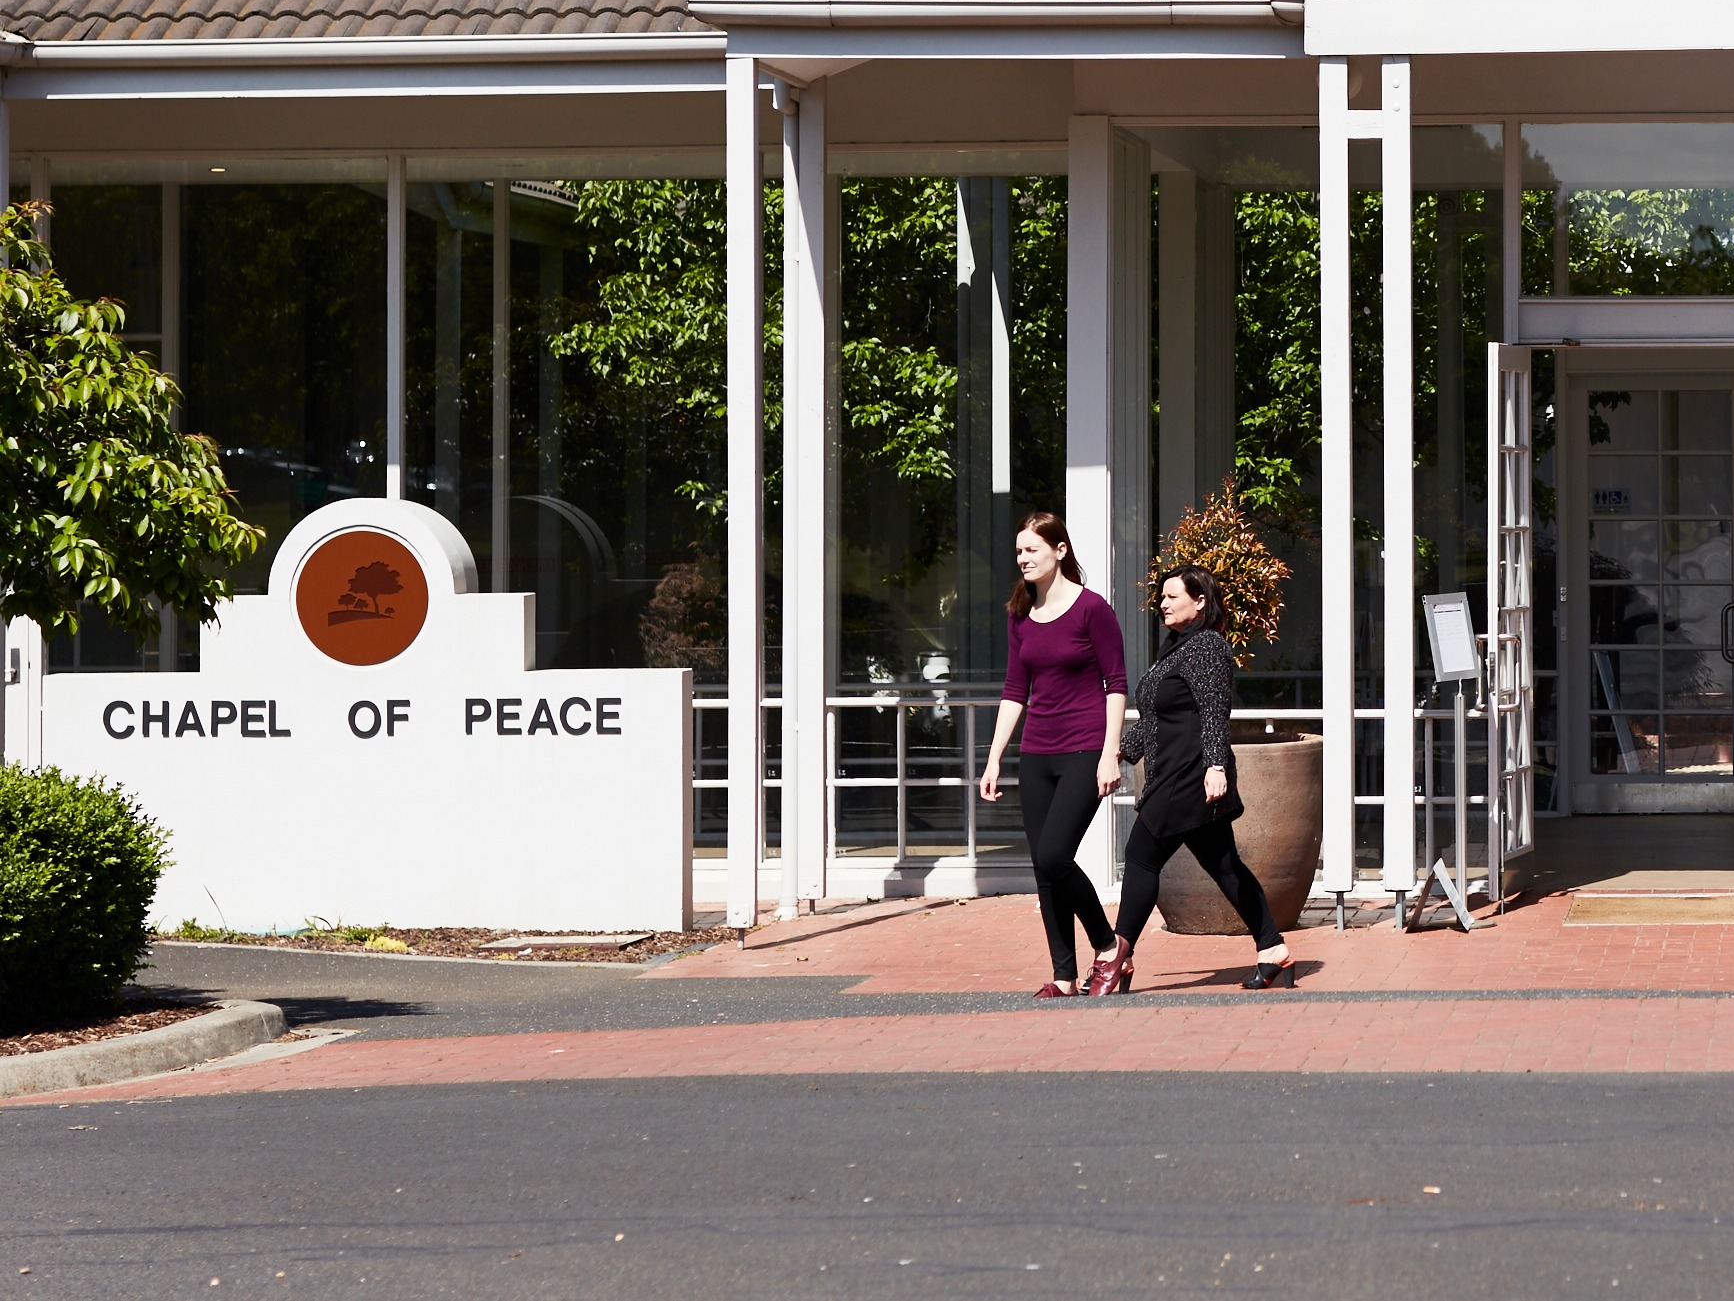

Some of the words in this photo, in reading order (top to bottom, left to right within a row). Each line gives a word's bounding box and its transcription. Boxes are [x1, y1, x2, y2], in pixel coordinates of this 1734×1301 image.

[102, 699, 292, 740] CHAPEL
[347, 699, 411, 740] OF
[465, 696, 622, 736] PEACE
